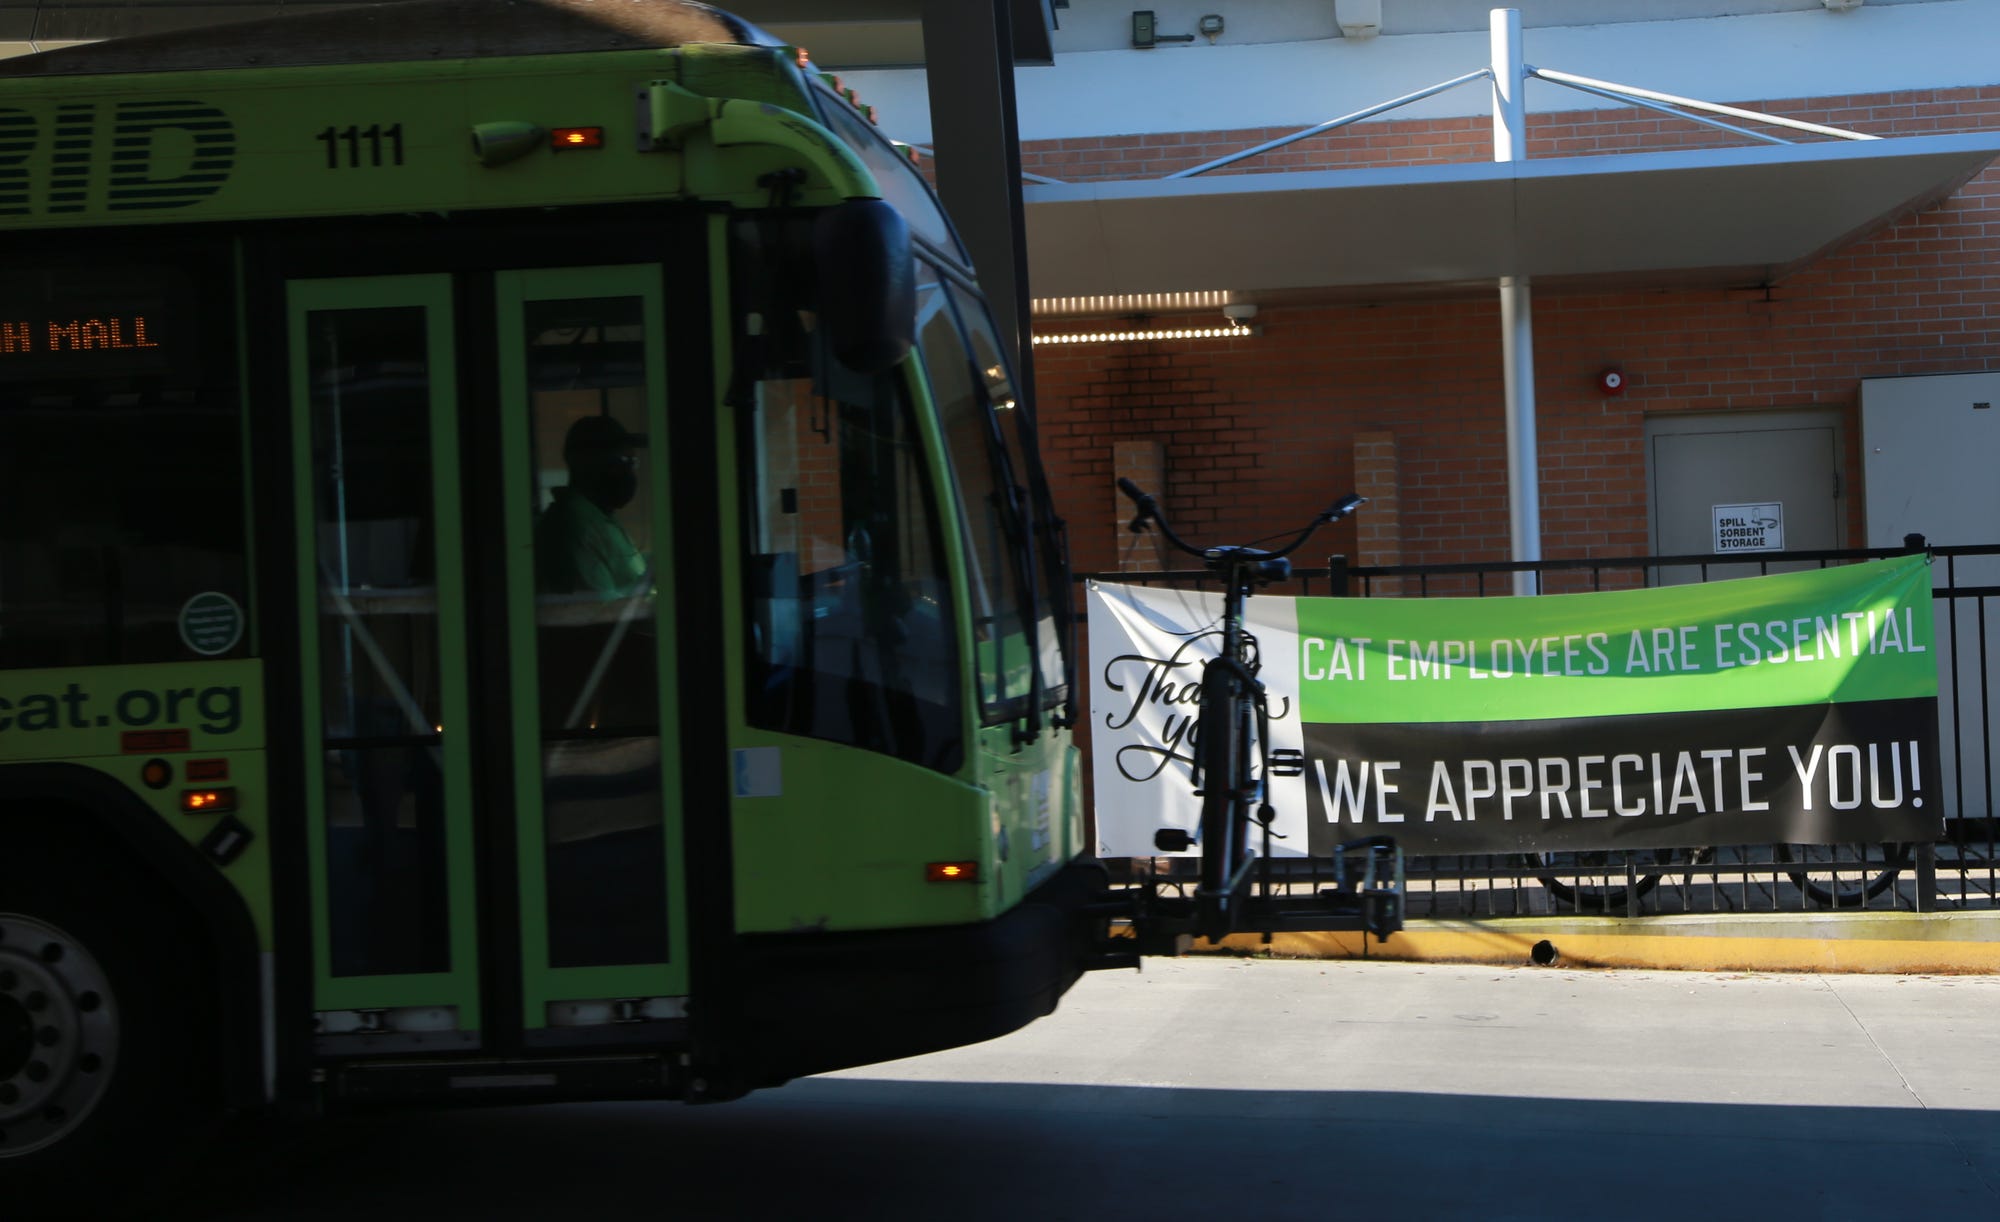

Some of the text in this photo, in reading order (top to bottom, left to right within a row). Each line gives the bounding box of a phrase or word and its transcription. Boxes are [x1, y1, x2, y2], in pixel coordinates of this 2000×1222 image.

[316, 123, 403, 169] 1111
[49, 316, 160, 351] MALL
[1719, 517, 1747, 528] SPILL
[1720, 527, 1766, 538] SORBENT
[1720, 537, 1766, 549] STORAGE
[1302, 606, 1927, 682] CAT EMPLOYEES ARE ESSENTIAL
[1313, 739, 1924, 824] WE APPRECIATE YOU!
